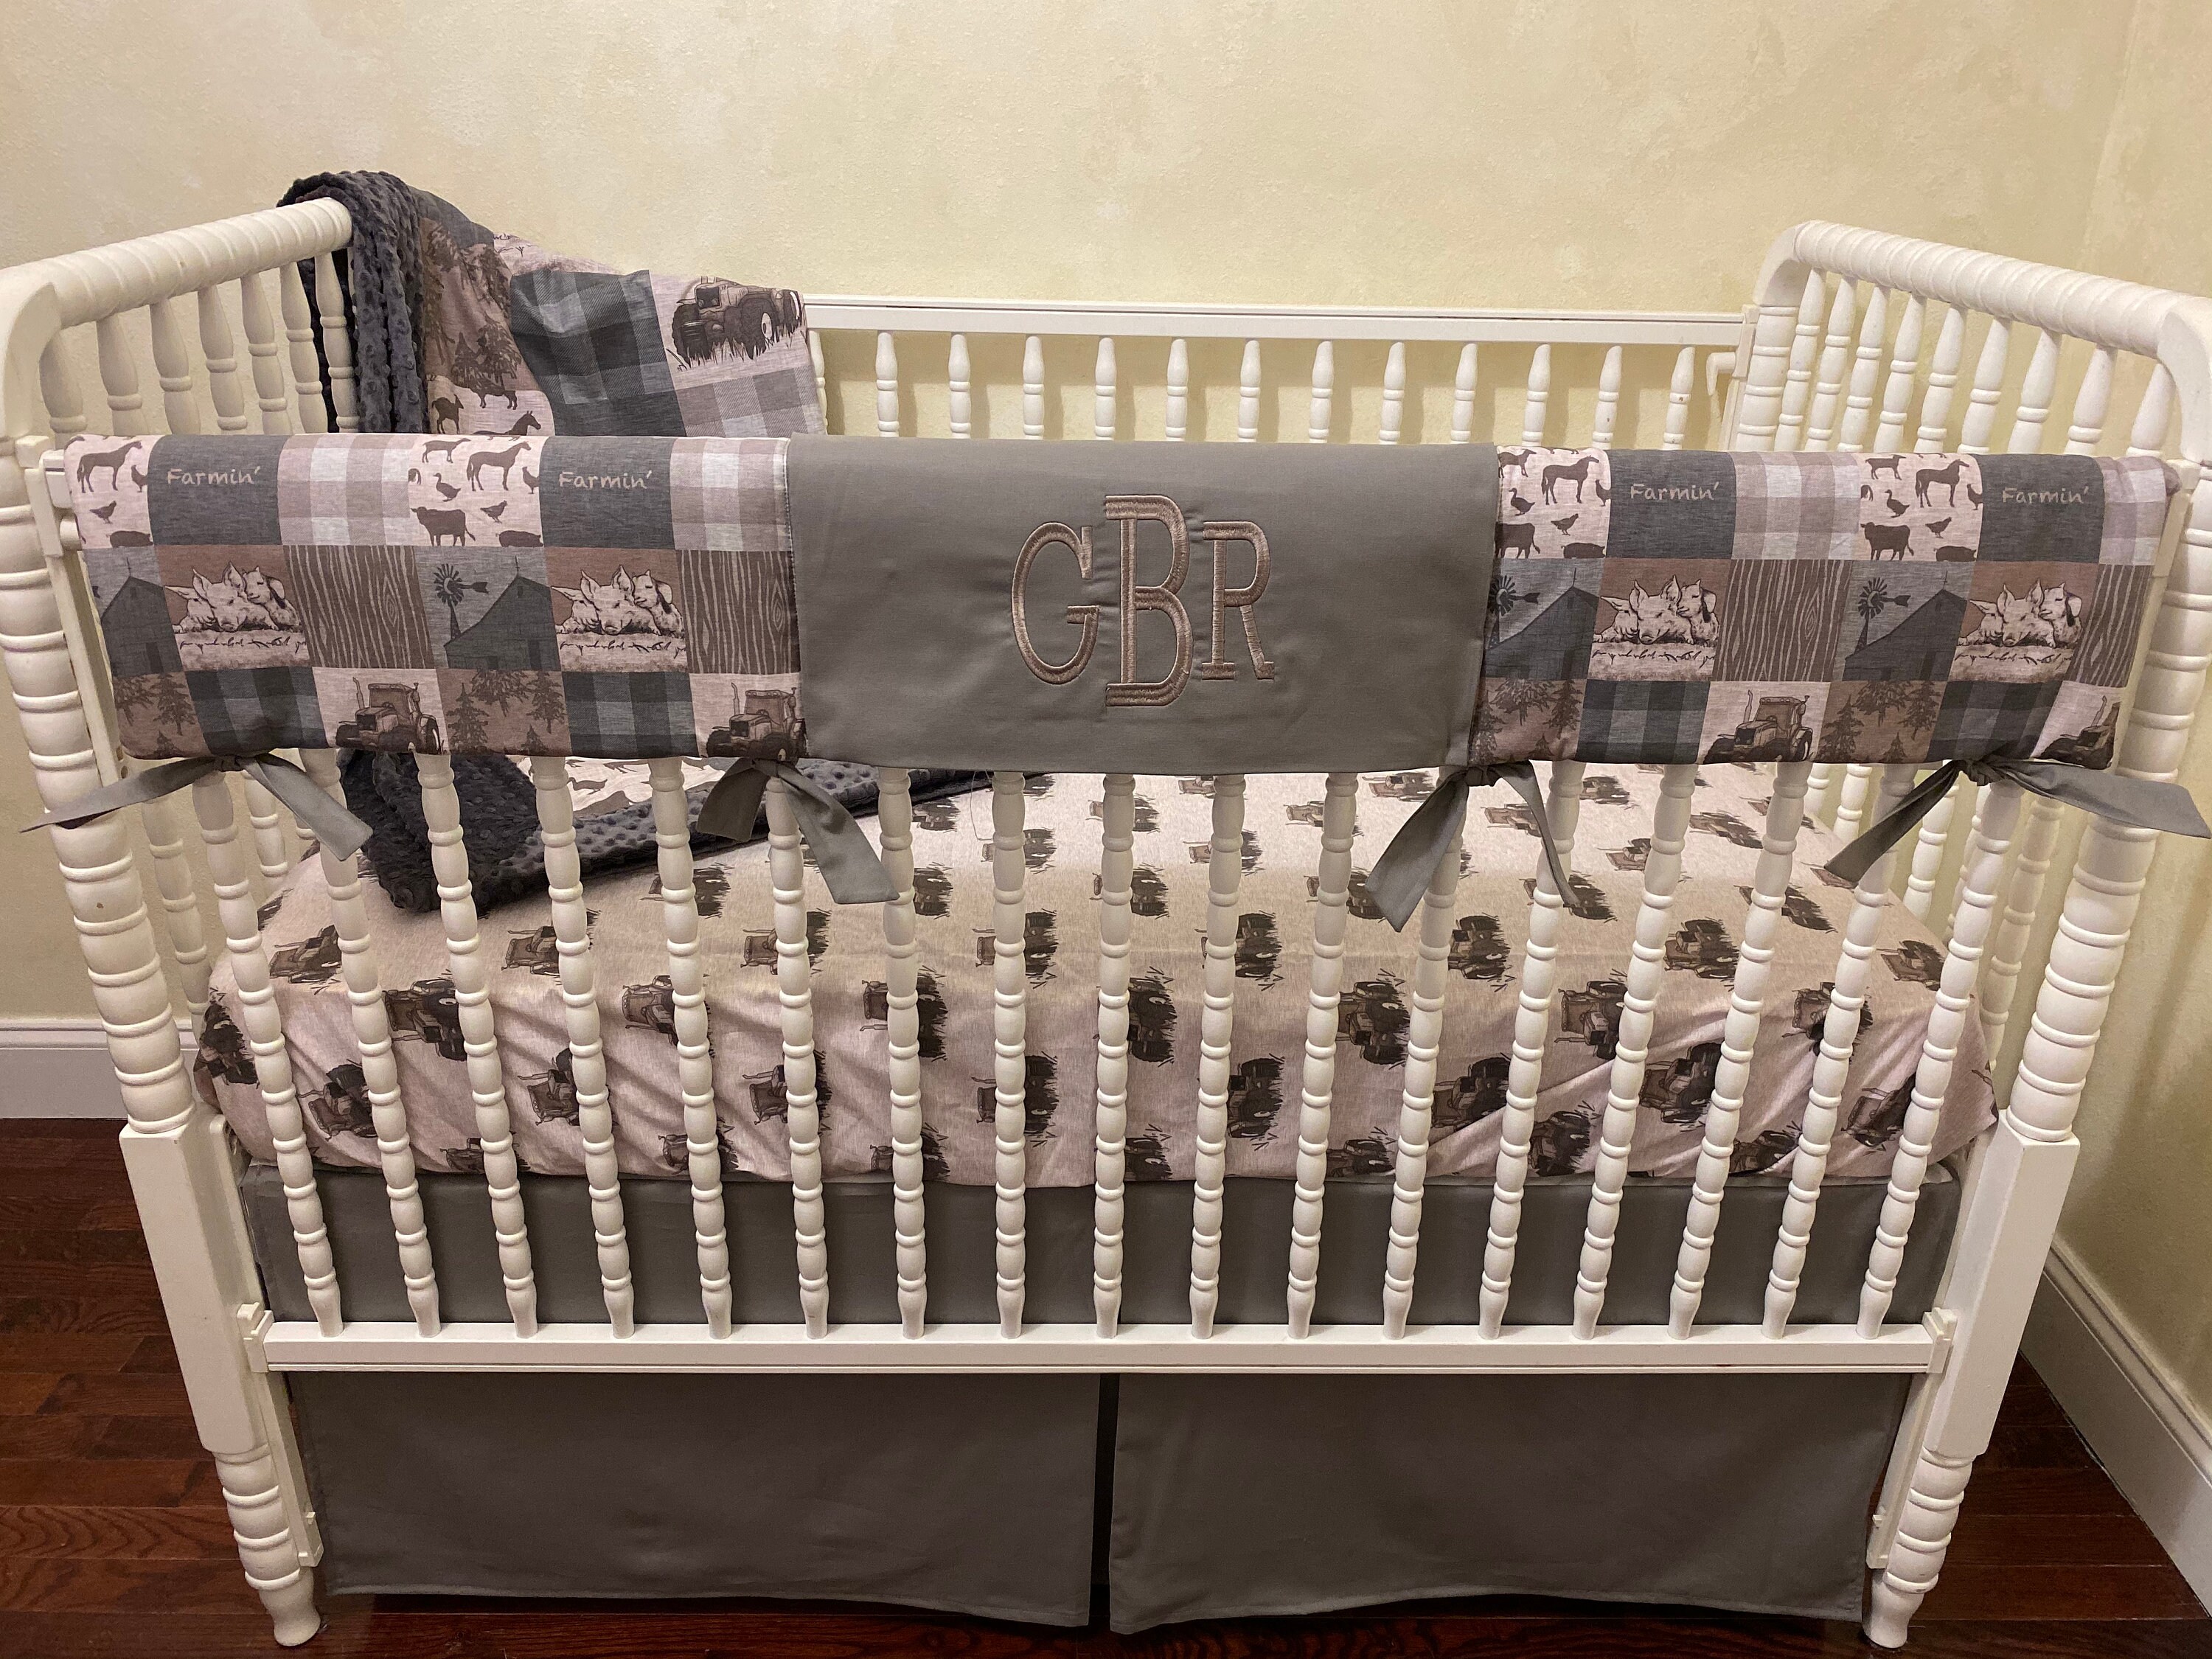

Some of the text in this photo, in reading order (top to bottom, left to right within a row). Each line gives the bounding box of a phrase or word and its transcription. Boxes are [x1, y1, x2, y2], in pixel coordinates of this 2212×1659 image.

[167, 465, 260, 486] Farmin'
[559, 470, 653, 490] Farmin'
[1630, 481, 1719, 501] Farmin'
[2002, 485, 2089, 504] Farmin'
